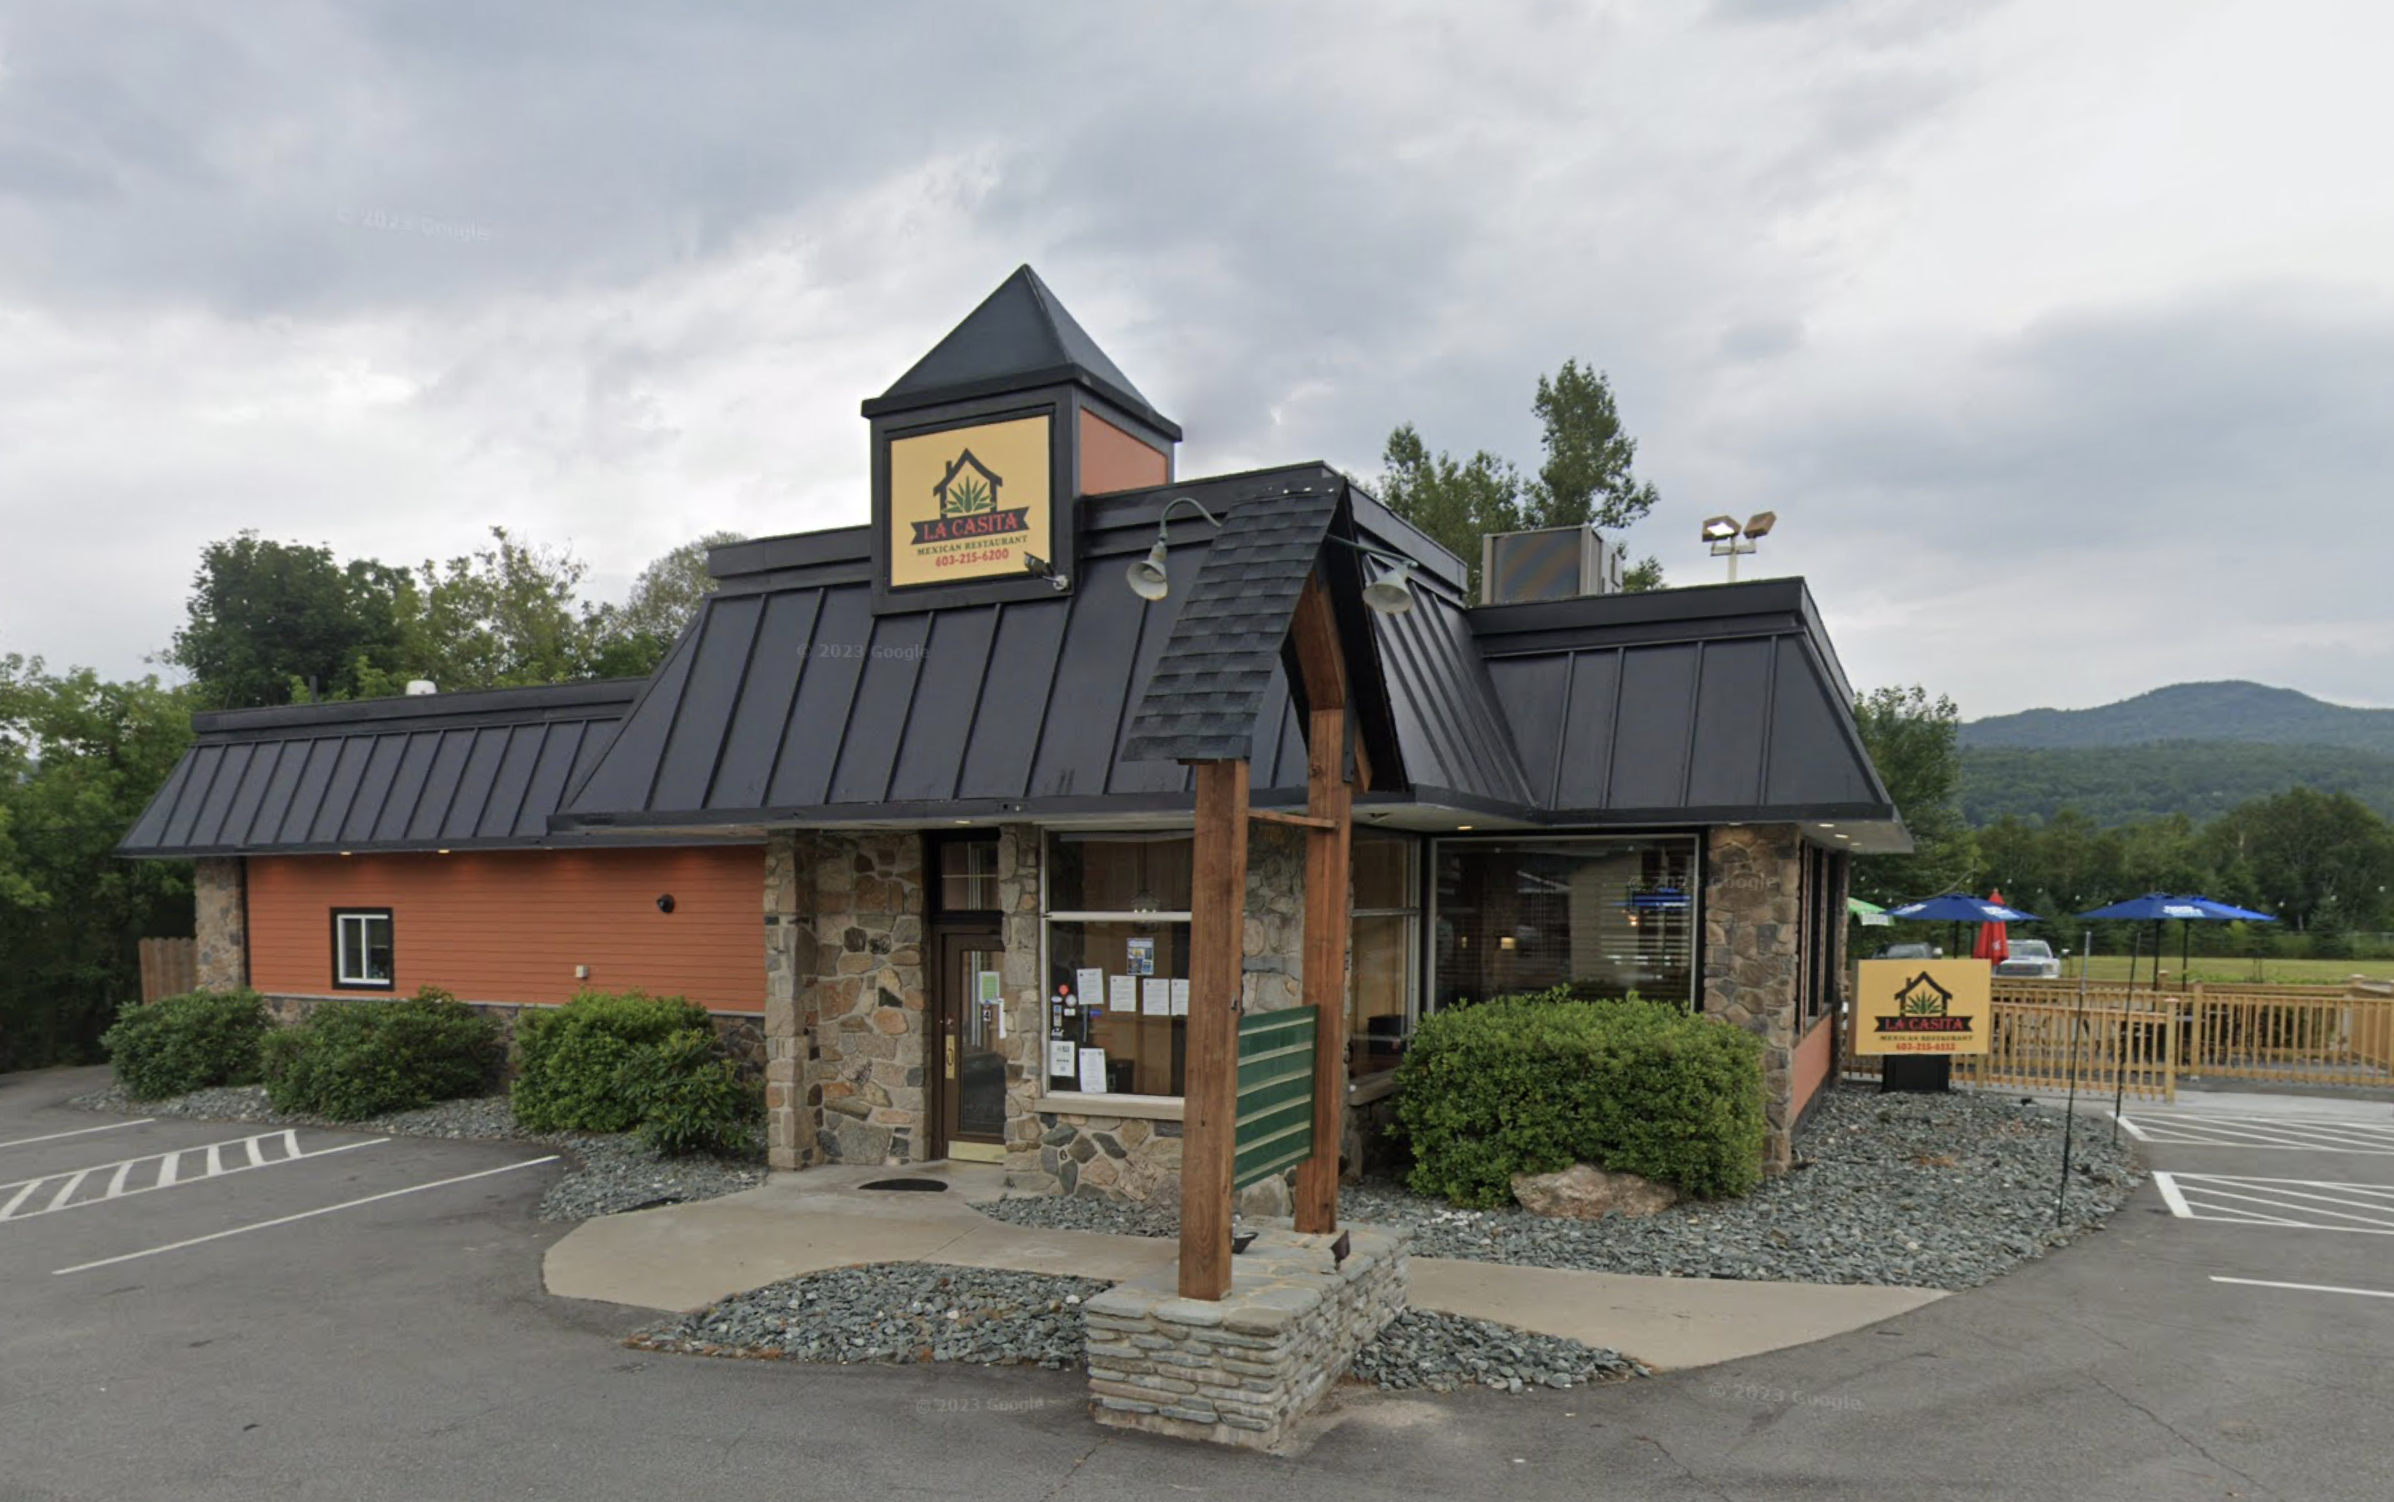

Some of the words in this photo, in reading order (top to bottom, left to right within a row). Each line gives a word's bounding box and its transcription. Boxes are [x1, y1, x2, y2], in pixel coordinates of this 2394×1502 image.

[923, 522, 948, 541] LA
[952, 512, 1018, 538] CASITA
[917, 543, 961, 555] MEXICAN
[965, 535, 1028, 550] RESTAURANT
[936, 549, 1009, 567] 603-215-6200
[1885, 1018, 1906, 1030] LA
[1909, 1018, 1964, 1030] CASITA
